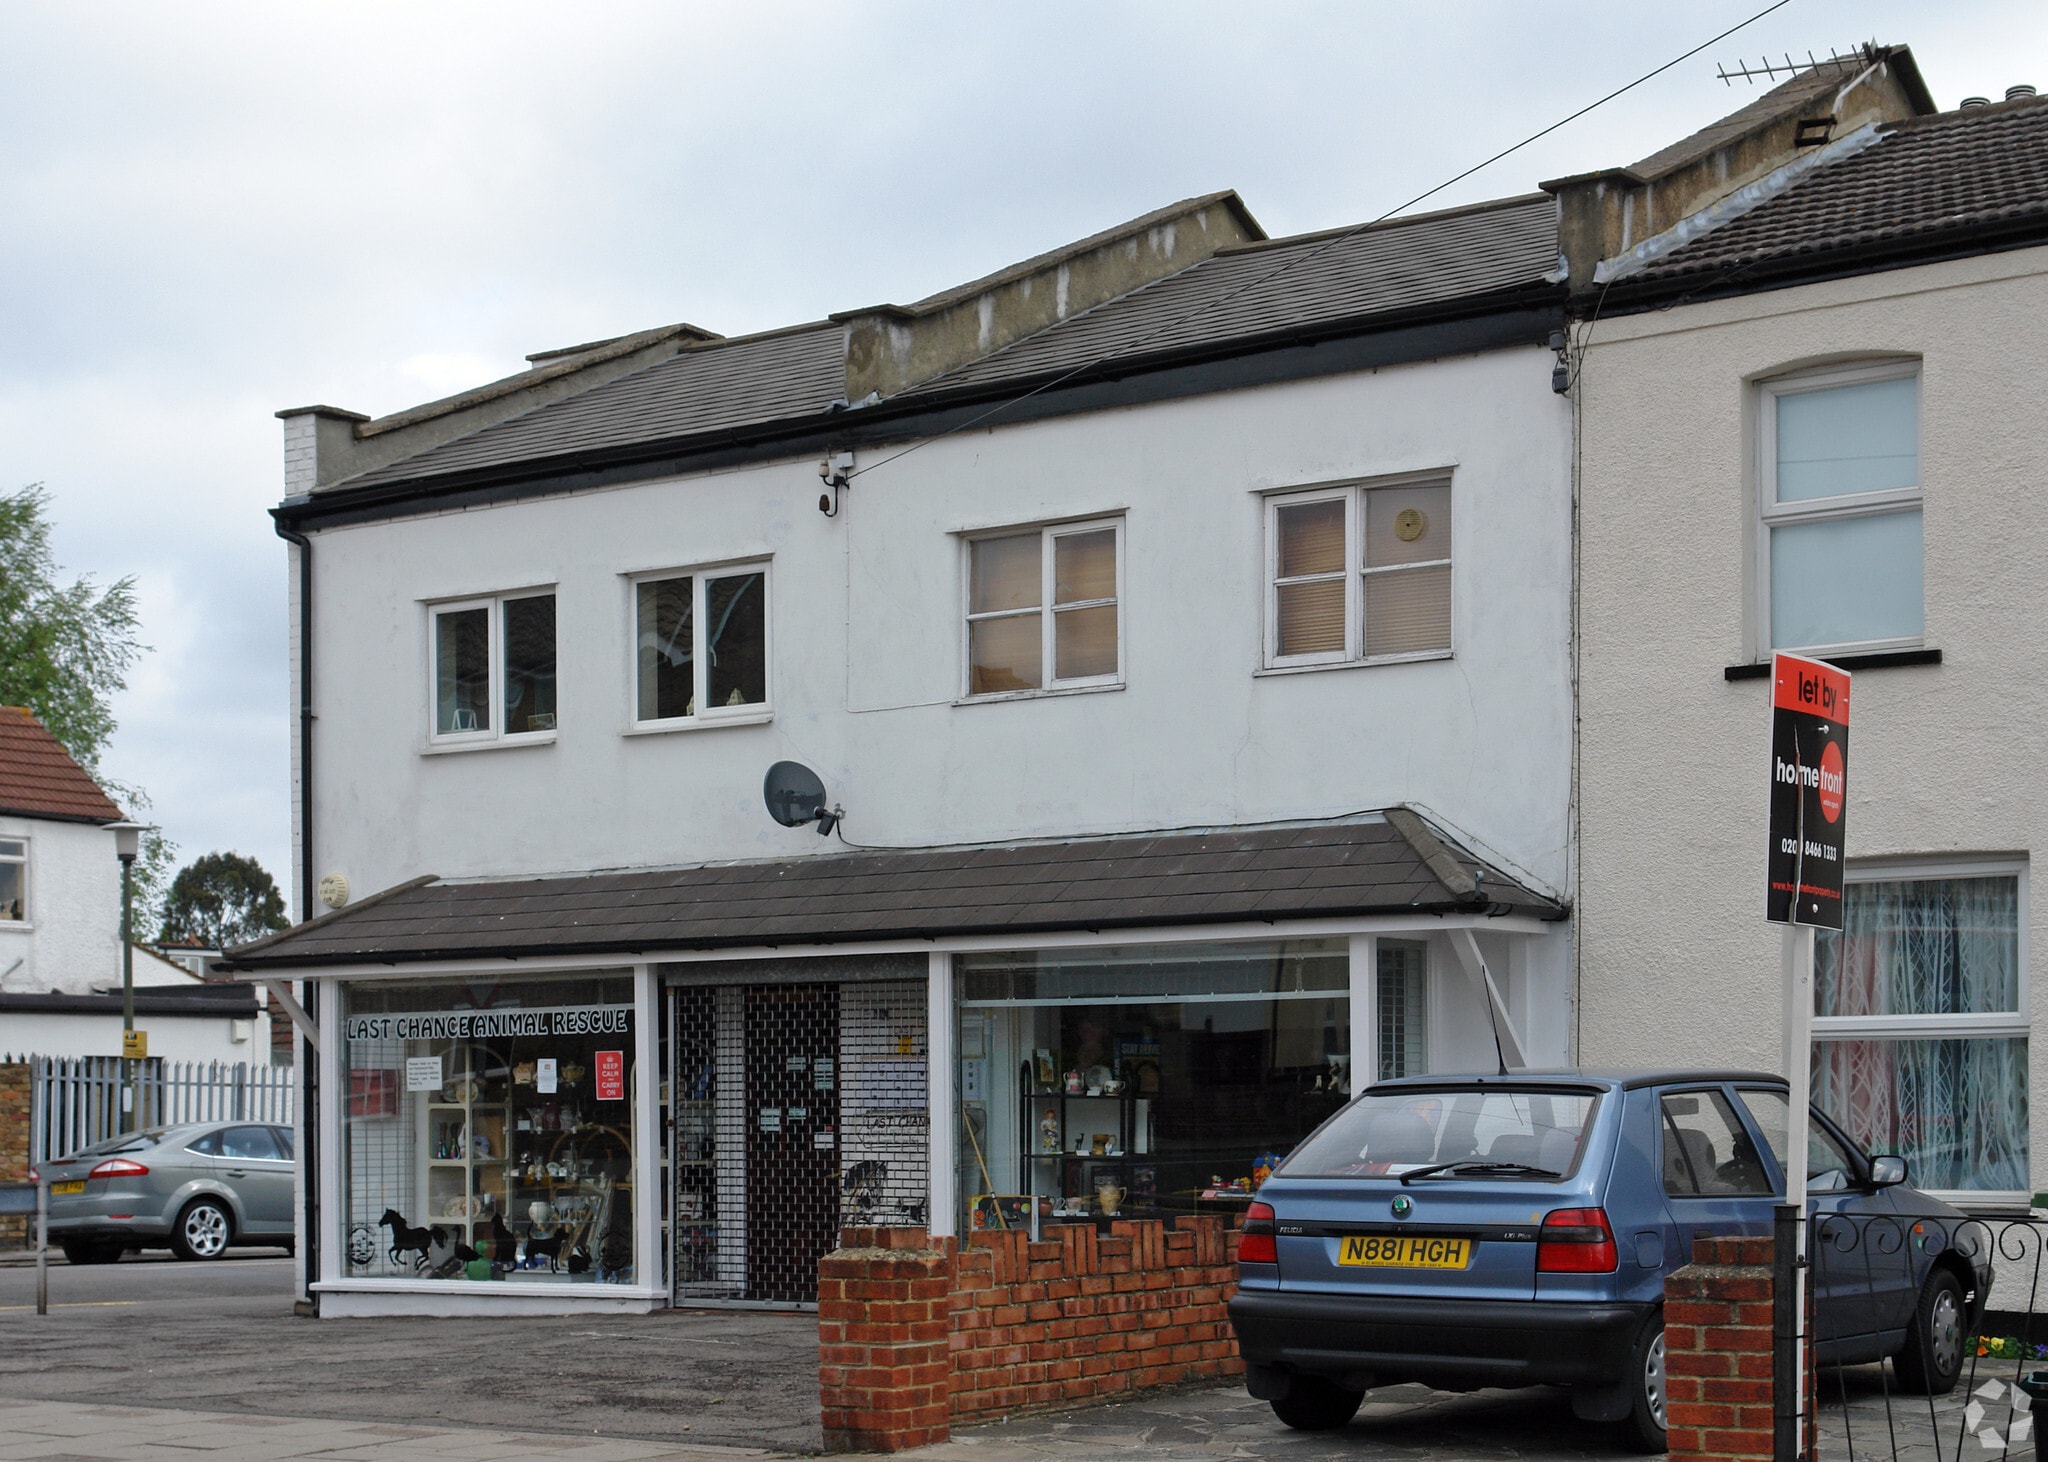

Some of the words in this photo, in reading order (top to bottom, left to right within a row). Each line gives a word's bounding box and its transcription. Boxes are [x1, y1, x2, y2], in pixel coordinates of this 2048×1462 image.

[1798, 671, 1819, 705] let
[1823, 677, 1837, 717] by
[1781, 837, 1797, 855] 020
[347, 1017, 391, 1040] LAST
[396, 1014, 470, 1039] CHANCE
[473, 1012, 549, 1037] ANIMAL
[552, 1009, 628, 1035] RESCUE
[602, 1062, 619, 1070] KEEP
[601, 1081, 620, 1089] CARRY
[1279, 1226, 1303, 1234] FELICIA
[1347, 1238, 1405, 1261] N881
[1409, 1239, 1462, 1263] HGH
